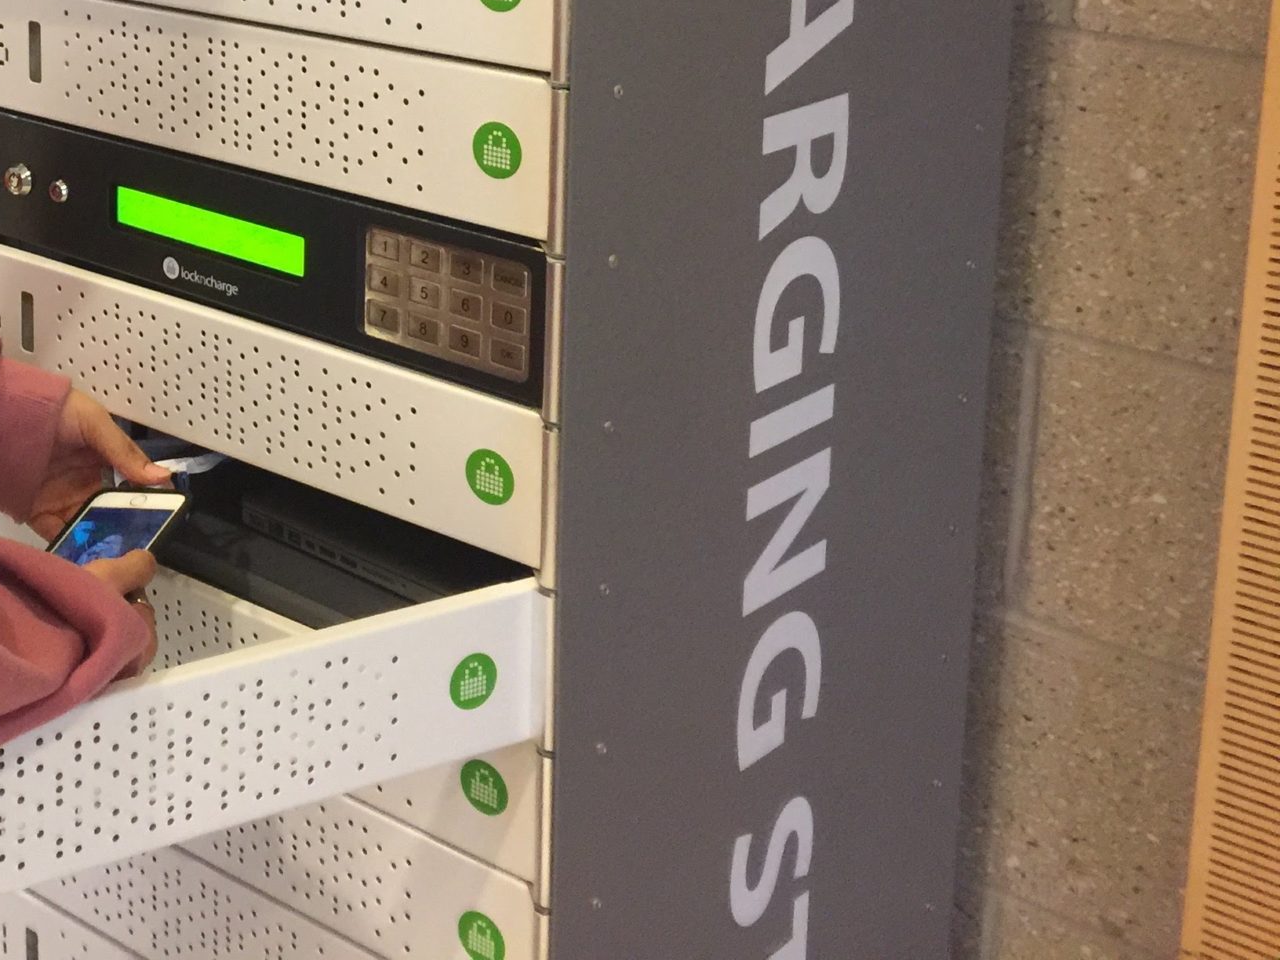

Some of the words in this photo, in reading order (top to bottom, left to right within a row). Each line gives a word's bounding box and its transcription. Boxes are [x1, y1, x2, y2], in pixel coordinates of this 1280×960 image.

[421, 250, 429, 265] 2
[462, 262, 471, 276] 3
[180, 265, 239, 297] lockncharge
[380, 275, 388, 288] 4
[420, 286, 429, 300] 5
[461, 298, 470, 312] 6
[379, 309, 387, 323] 7
[460, 334, 469, 349] 9
